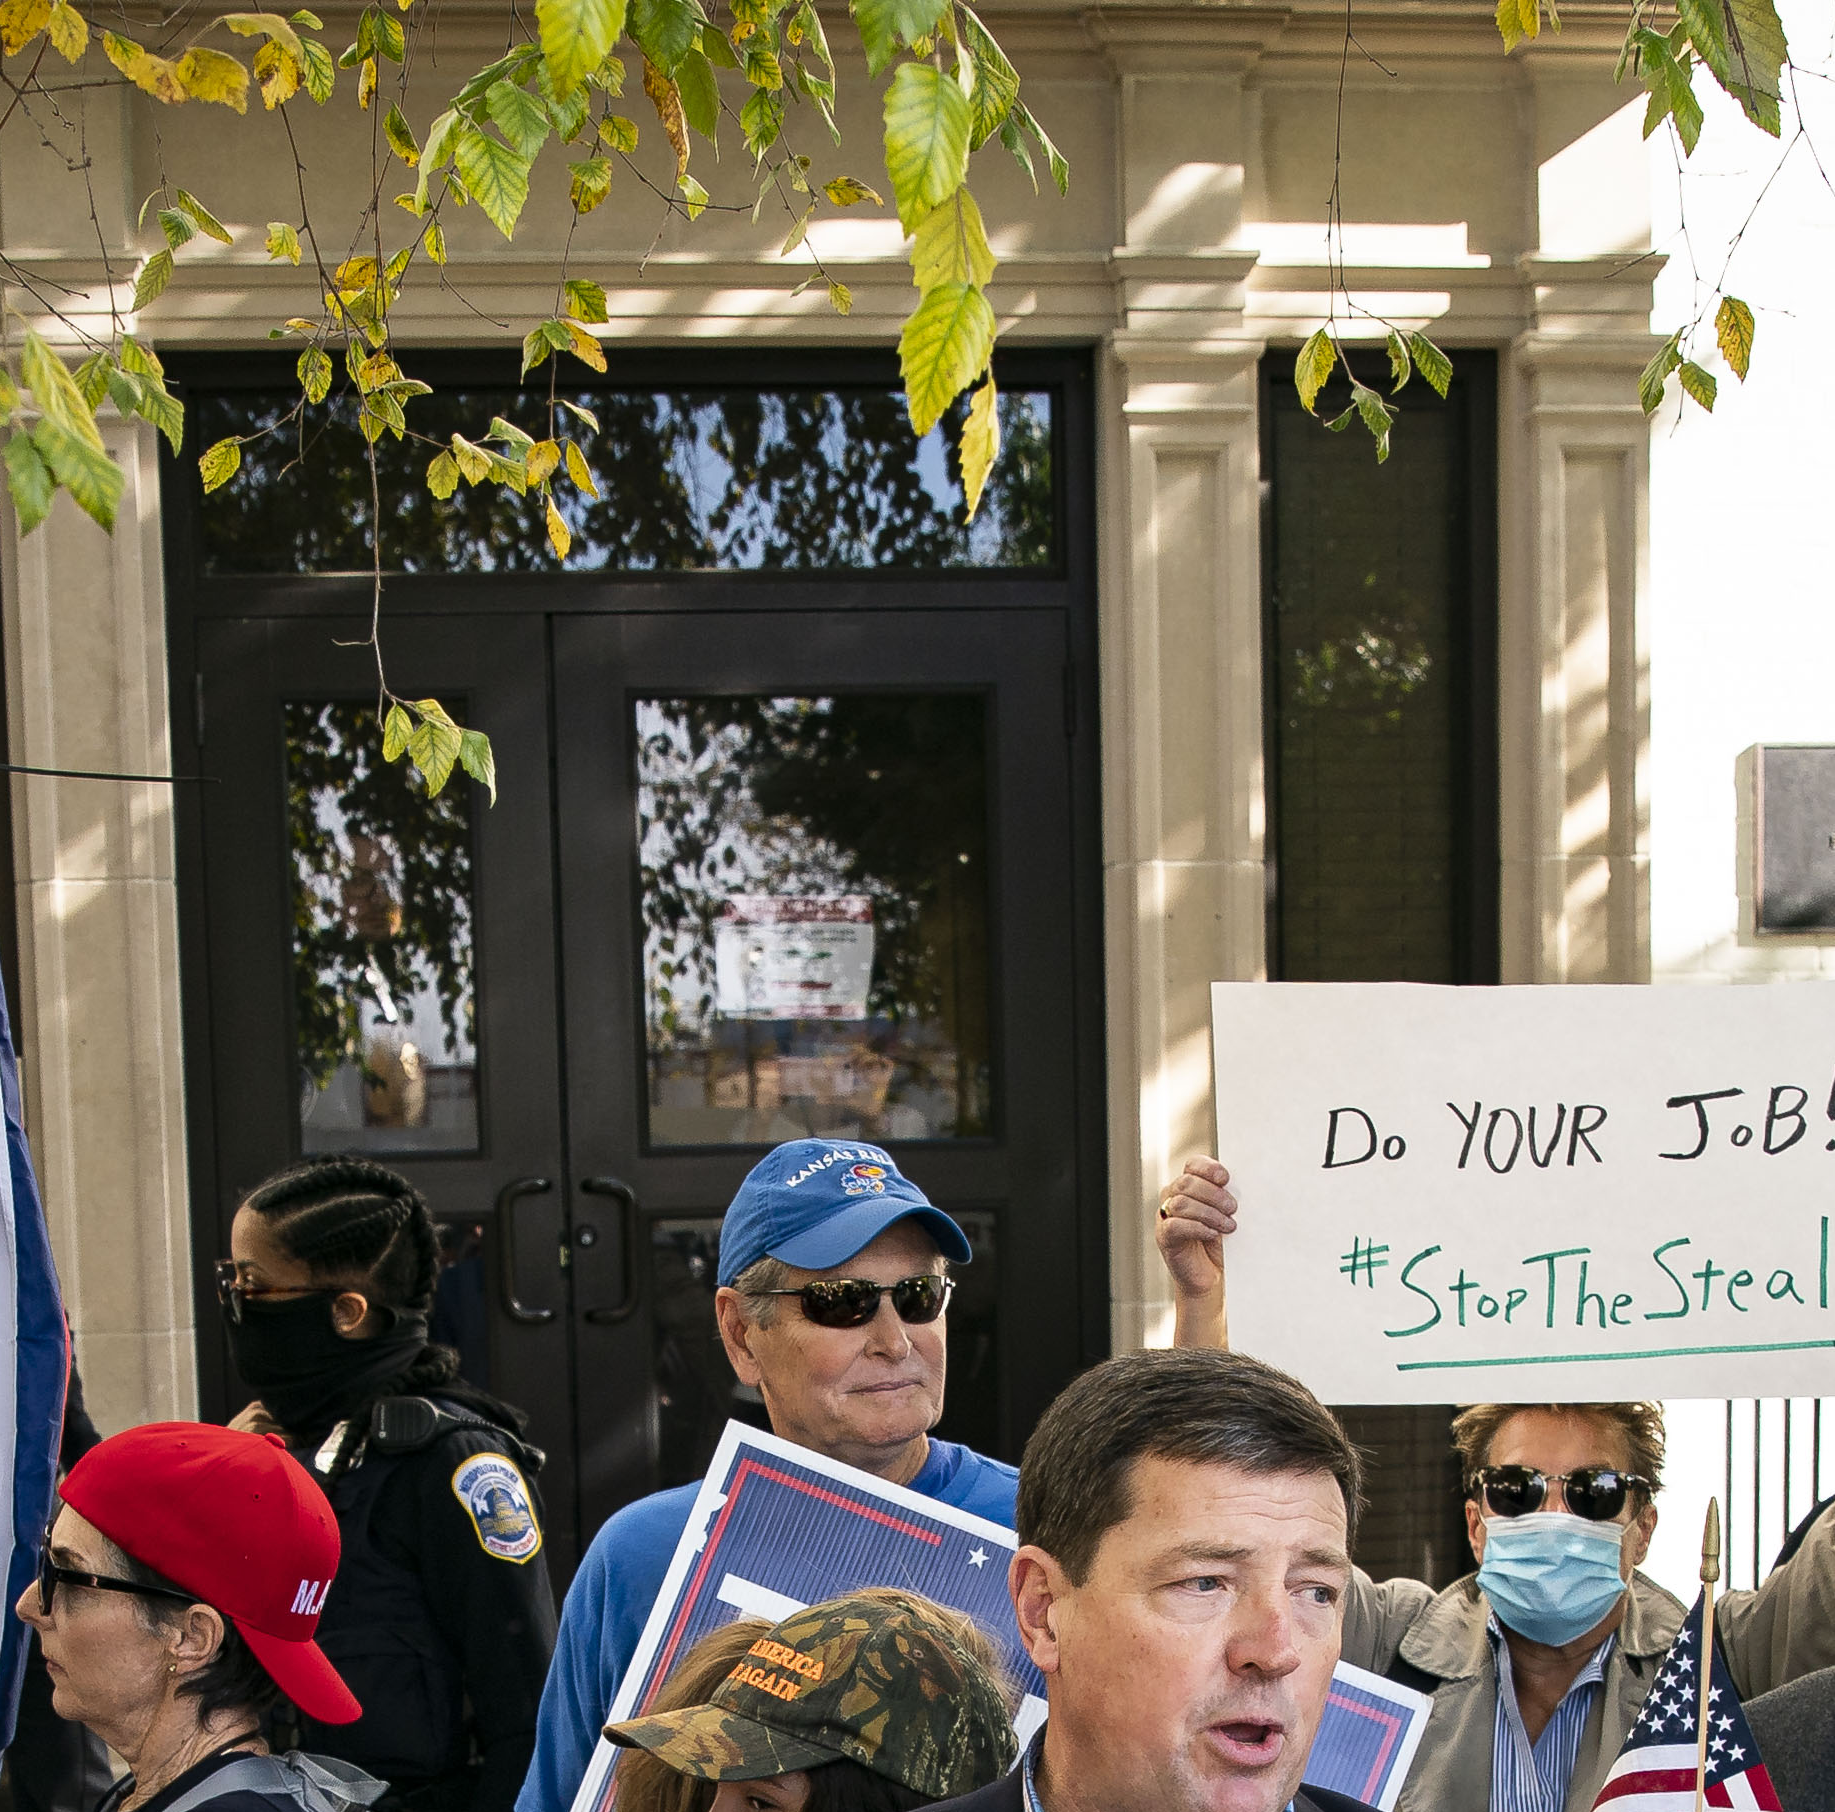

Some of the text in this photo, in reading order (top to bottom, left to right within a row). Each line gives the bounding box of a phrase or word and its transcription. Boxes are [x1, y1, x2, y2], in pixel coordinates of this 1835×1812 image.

[785, 1149, 856, 1189] KANSAS
[1322, 1105, 1407, 1169] Do
[1446, 1100, 1608, 1175] YOUR
[1337, 1215, 1829, 1339] #StopTheSteal
